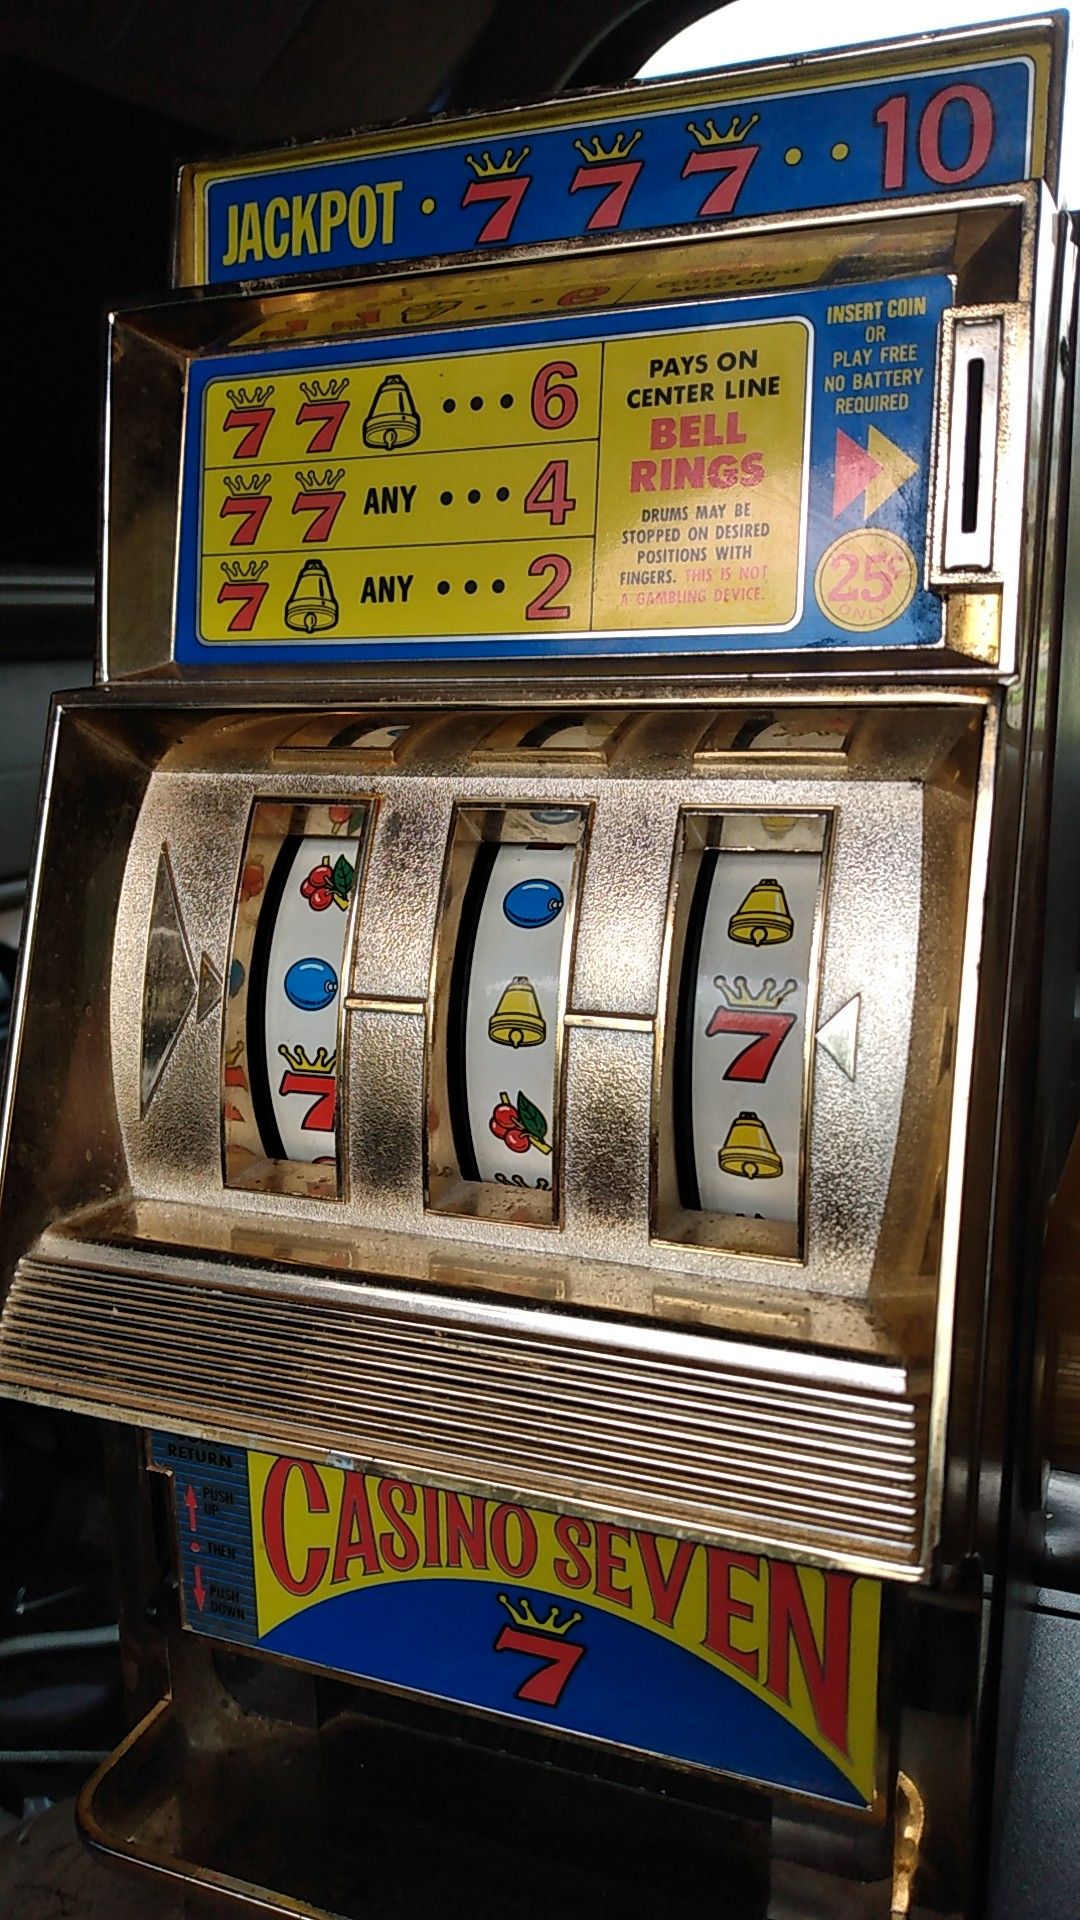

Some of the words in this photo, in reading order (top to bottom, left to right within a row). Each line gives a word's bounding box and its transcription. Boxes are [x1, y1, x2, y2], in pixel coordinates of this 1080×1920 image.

[222, 180, 404, 267] JACKPOT
[461, 175, 533, 245] 7
[569, 159, 645, 231] 7
[682, 144, 761, 217] 7
[875, 82, 996, 192] 10
[826, 300, 883, 325] INSERT
[887, 296, 927, 319] COIN
[864, 325, 887, 343] OR
[650, 353, 708, 379] PAYS
[716, 349, 758, 372] ON
[832, 348, 873, 368] PLAY
[880, 343, 918, 364] FREE
[626, 382, 715, 409] CENTER
[725, 375, 781, 400] LINE
[824, 374, 846, 393] NO
[852, 367, 925, 391] BATTERY
[222, 406, 275, 460] 7
[295, 399, 351, 454] 7
[530, 360, 580, 431] 6
[835, 392, 910, 416] REQUIRED
[650, 411, 748, 450] BELL
[630, 452, 765, 494] RINGS
[220, 494, 273, 547] 7
[292, 490, 347, 543] 7
[363, 484, 418, 516] ANY
[524, 459, 577, 527] 4
[641, 505, 689, 523] DRUMS
[695, 503, 727, 520] MAY
[735, 502, 751, 517] BE
[621, 528, 681, 545] STOPPED
[688, 526, 709, 541] ON
[715, 522, 771, 540] DESIRED
[637, 547, 708, 565] POSITIONS
[716, 545, 753, 561] WITH
[619, 570, 678, 586] FINGERS.
[684, 566, 713, 582] THIS
[720, 566, 732, 581] IS
[739, 565, 769, 580] NOT
[217, 580, 270, 632] 7
[360, 574, 415, 605] ANY
[525, 553, 573, 621] 2
[619, 594, 629, 607] A
[636, 589, 707, 606] GAMBLING
[714, 586, 766, 603] DEVICE.
[838, 602, 887, 620] ONLY
[706, 1005, 798, 1084] 7
[278, 1070, 336, 1132] 7
[167, 1442, 233, 1470] RETURN
[203, 1486, 235, 1506] PUSH
[203, 1502, 220, 1518] UP
[207, 1541, 237, 1560] THEN
[209, 1584, 241, 1604] PUSH
[210, 1600, 246, 1621] DOWN
[262, 1456, 539, 1598] CASINO
[553, 1512, 860, 1765] SEVEN
[493, 1623, 588, 1709] 7
